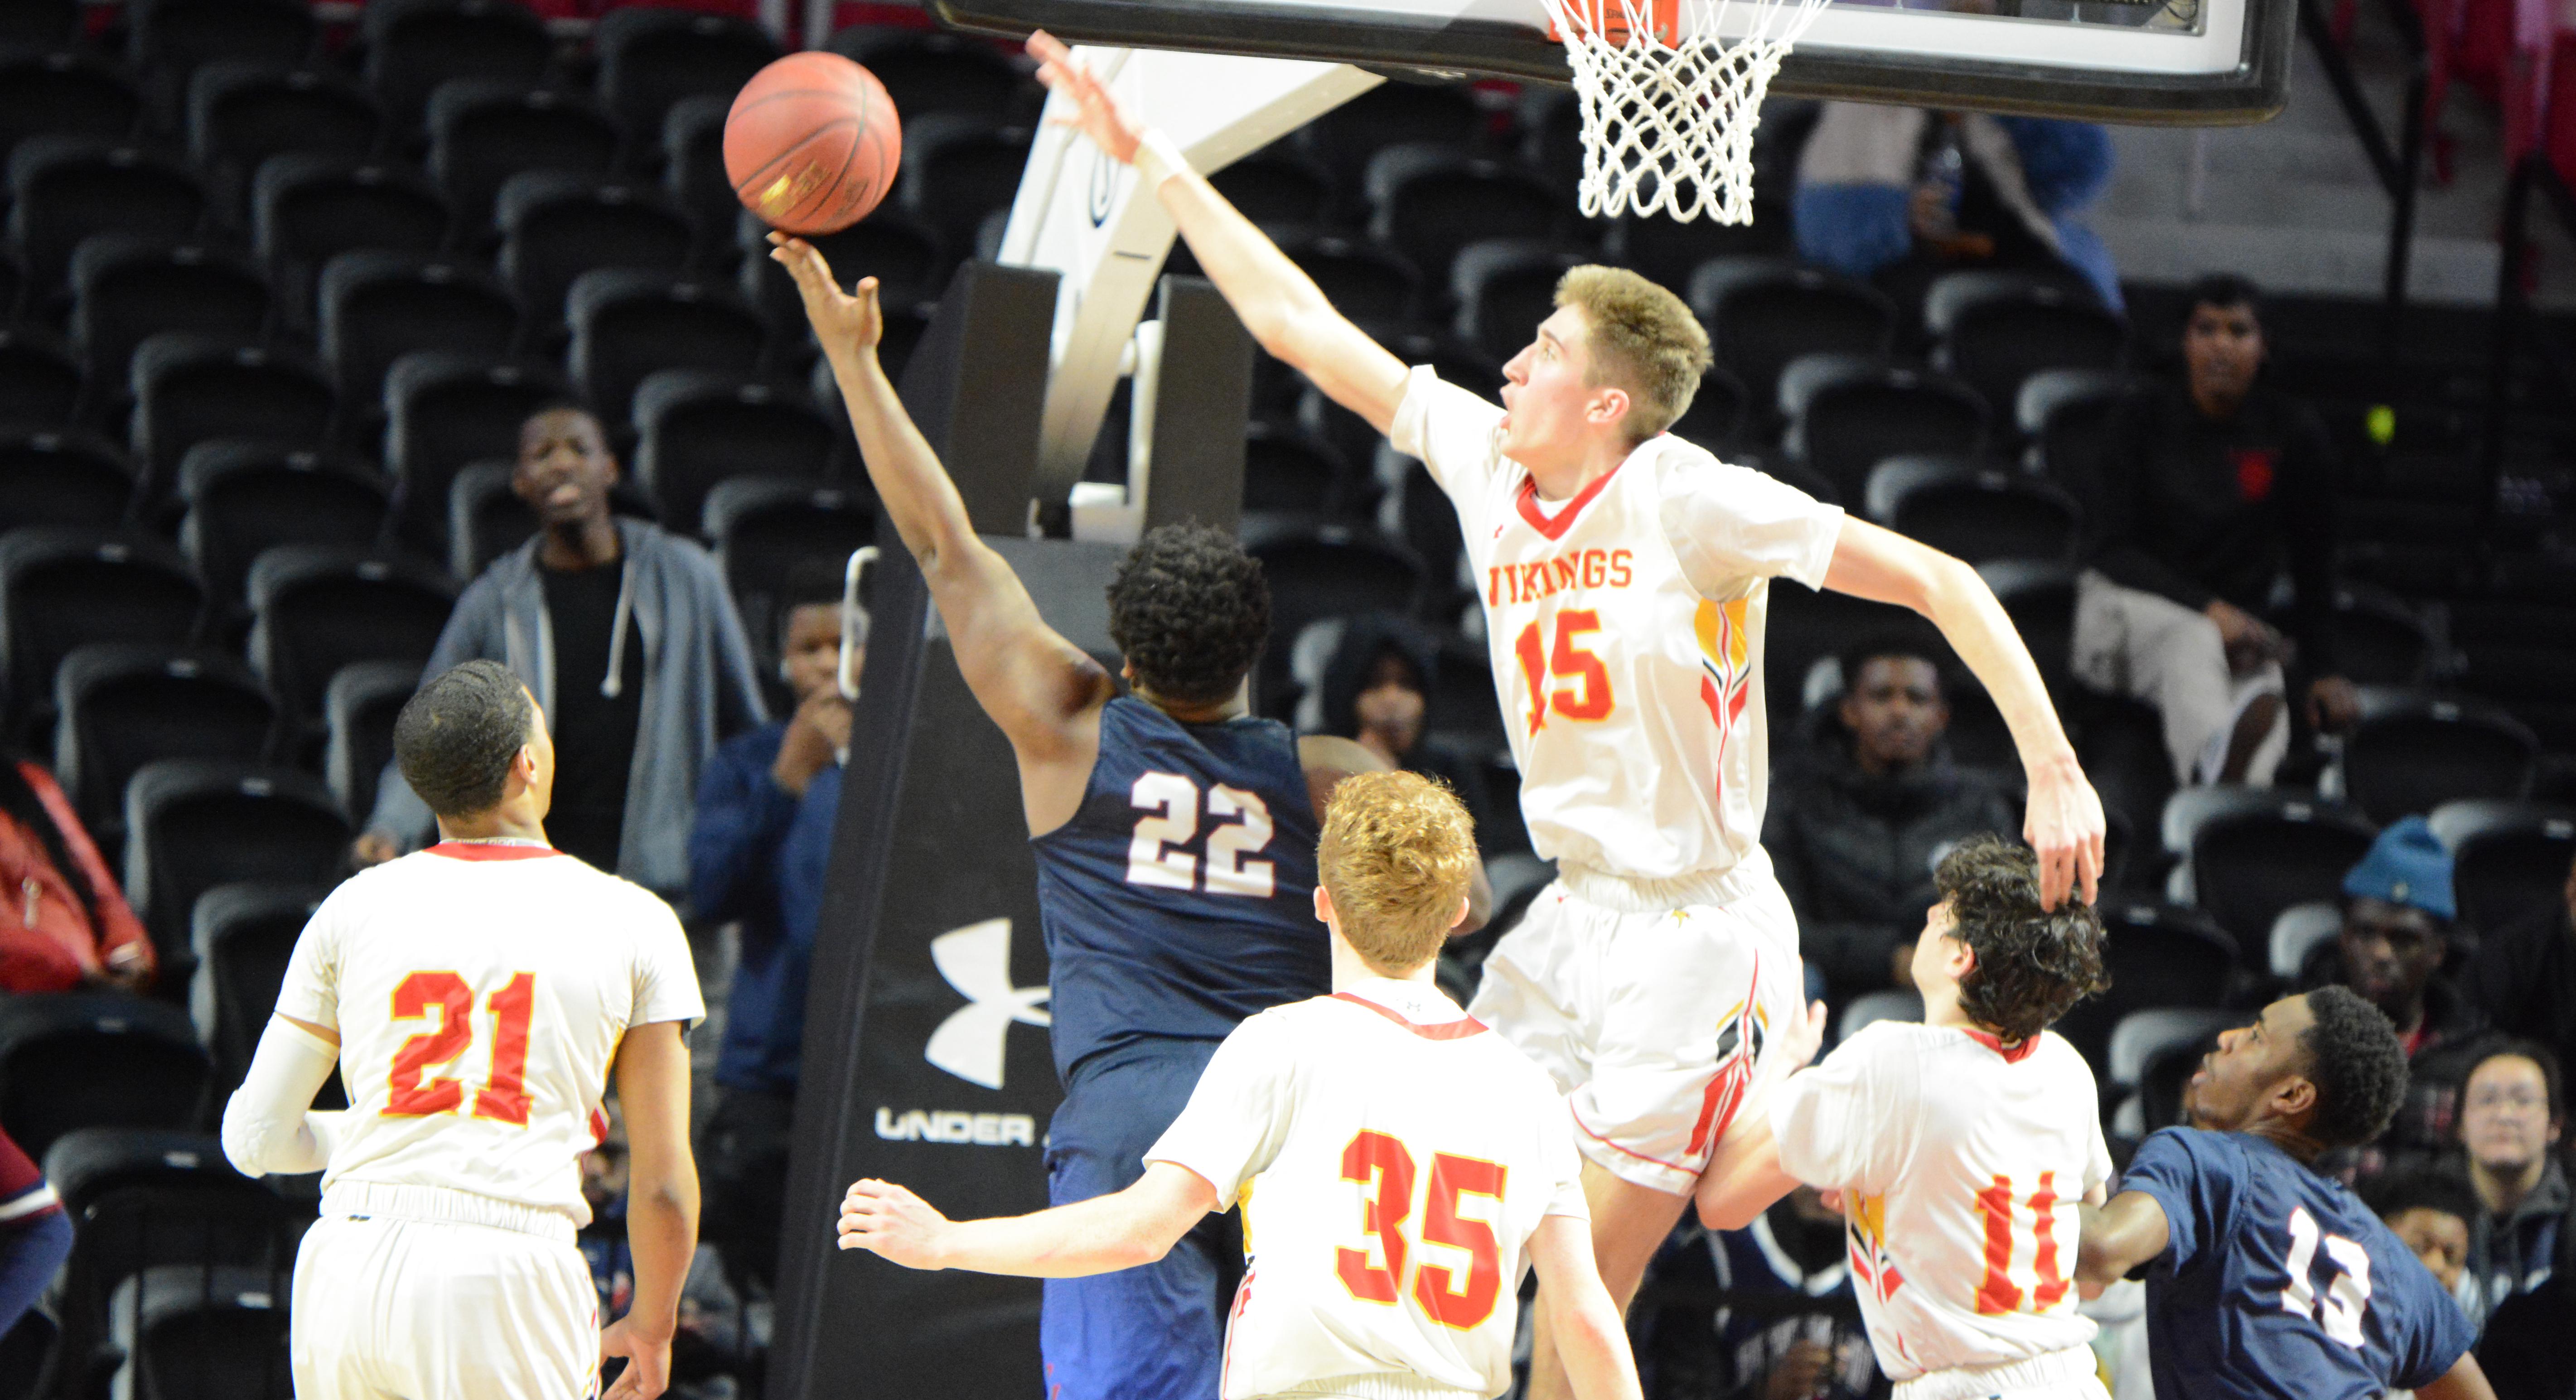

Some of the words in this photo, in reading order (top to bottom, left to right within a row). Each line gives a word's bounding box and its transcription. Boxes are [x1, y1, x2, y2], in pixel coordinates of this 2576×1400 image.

[1515, 609, 1616, 739] 15
[1126, 770, 1276, 899] 22
[378, 970, 536, 1130] 21
[875, 1106, 1035, 1147] UNDER
[1334, 1128, 1508, 1332] 35
[1974, 1170, 2071, 1315] 11
[2281, 1205, 2371, 1349] 13
